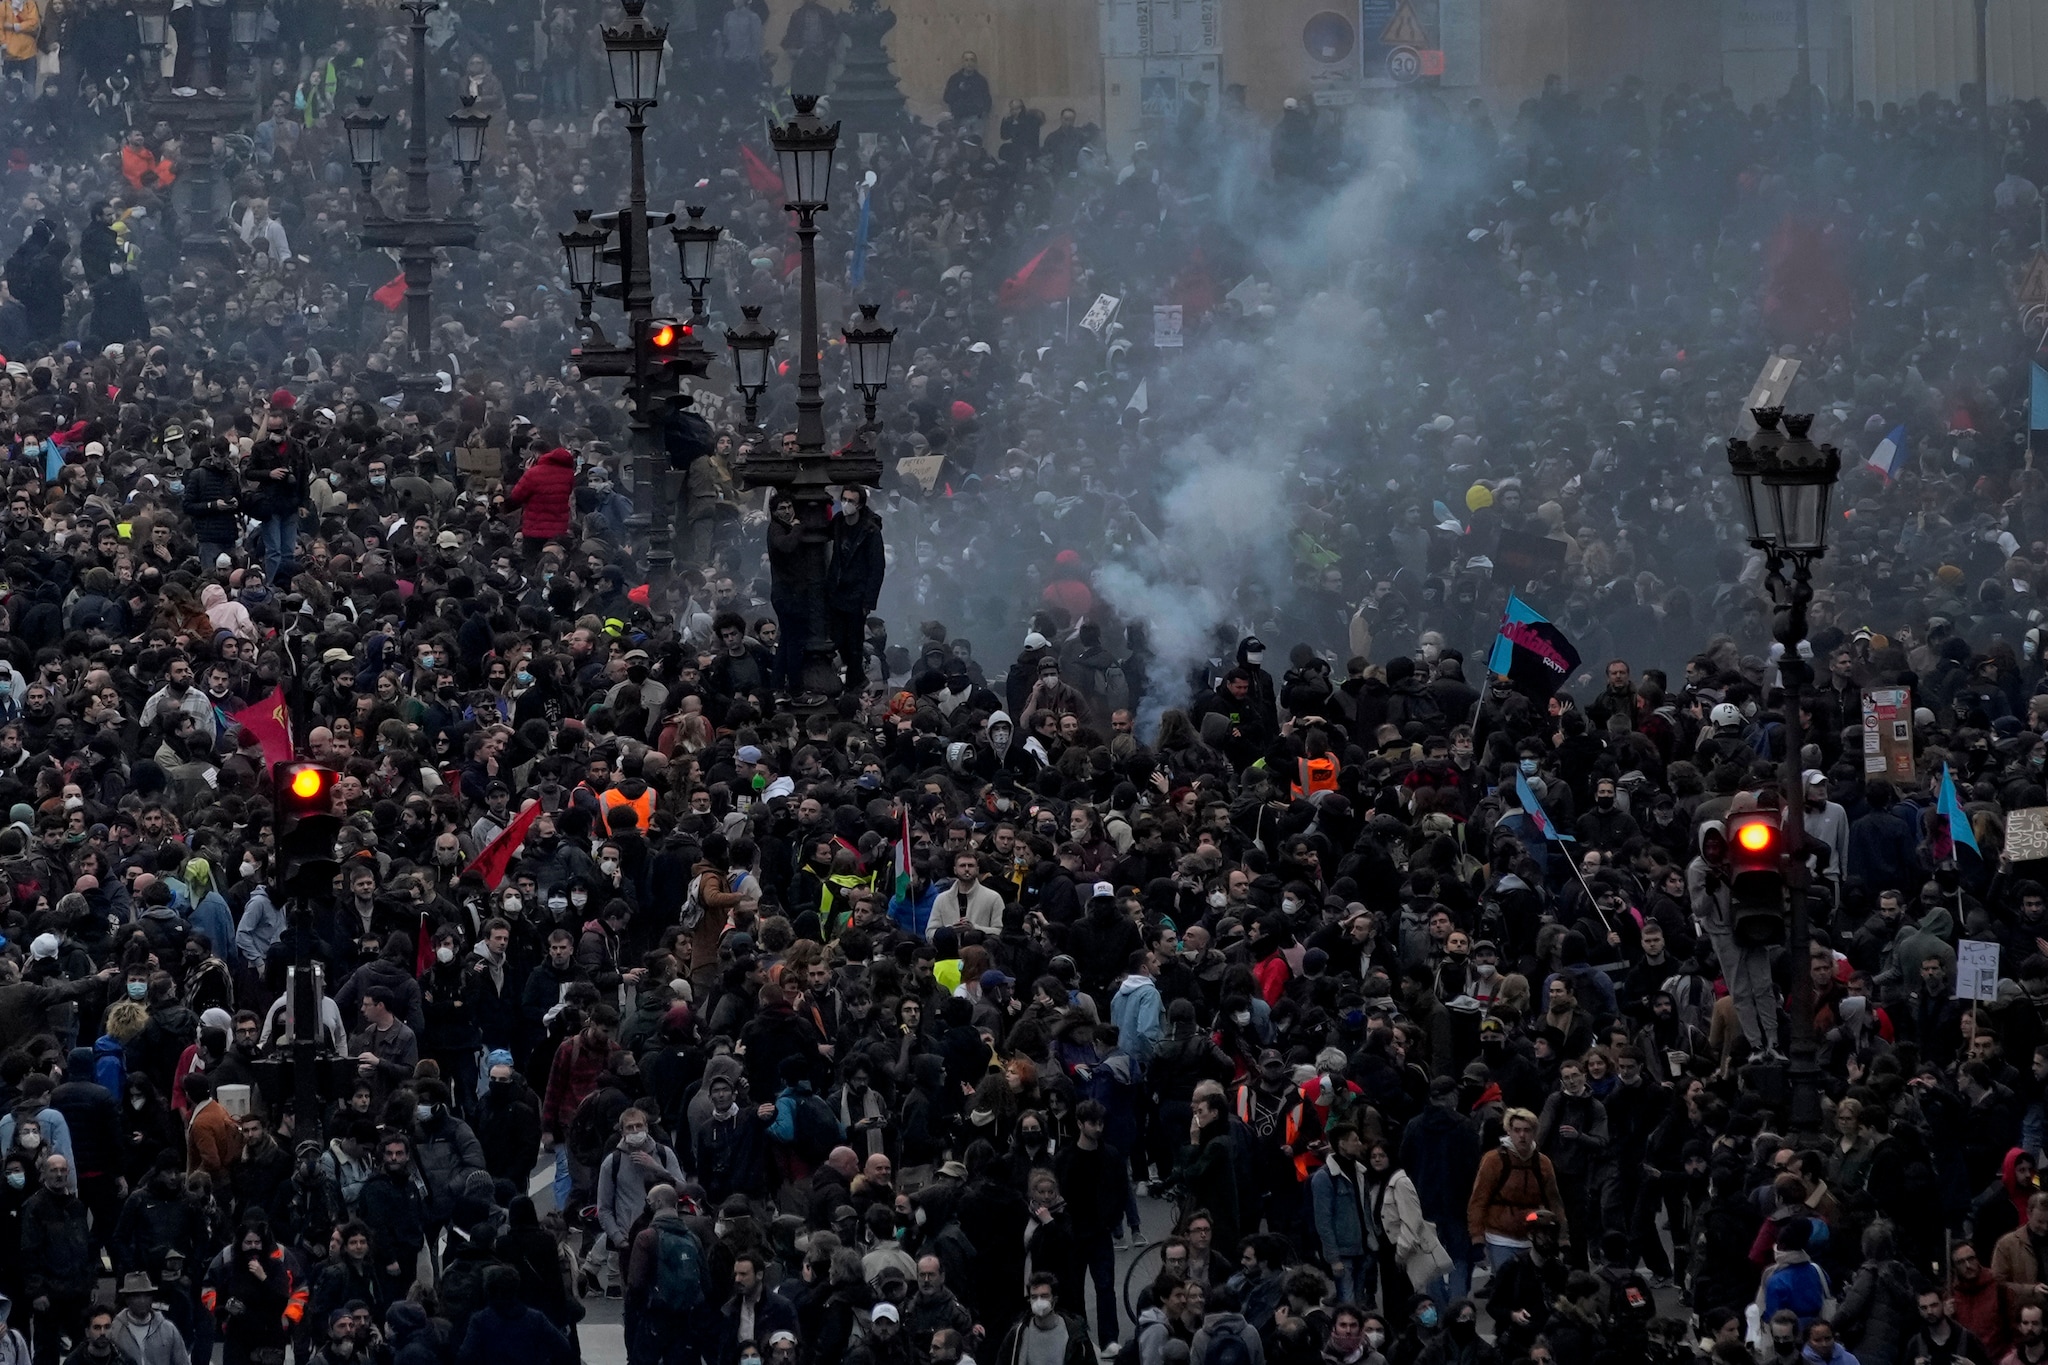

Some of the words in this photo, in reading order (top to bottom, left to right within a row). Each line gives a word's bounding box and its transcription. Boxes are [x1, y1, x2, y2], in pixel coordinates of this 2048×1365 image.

[1392, 57, 1416, 73] 30
[1543, 656, 1566, 673] RATP
[951, 745, 961, 760] ORK
[2007, 810, 2026, 860] HYPOCRITE
